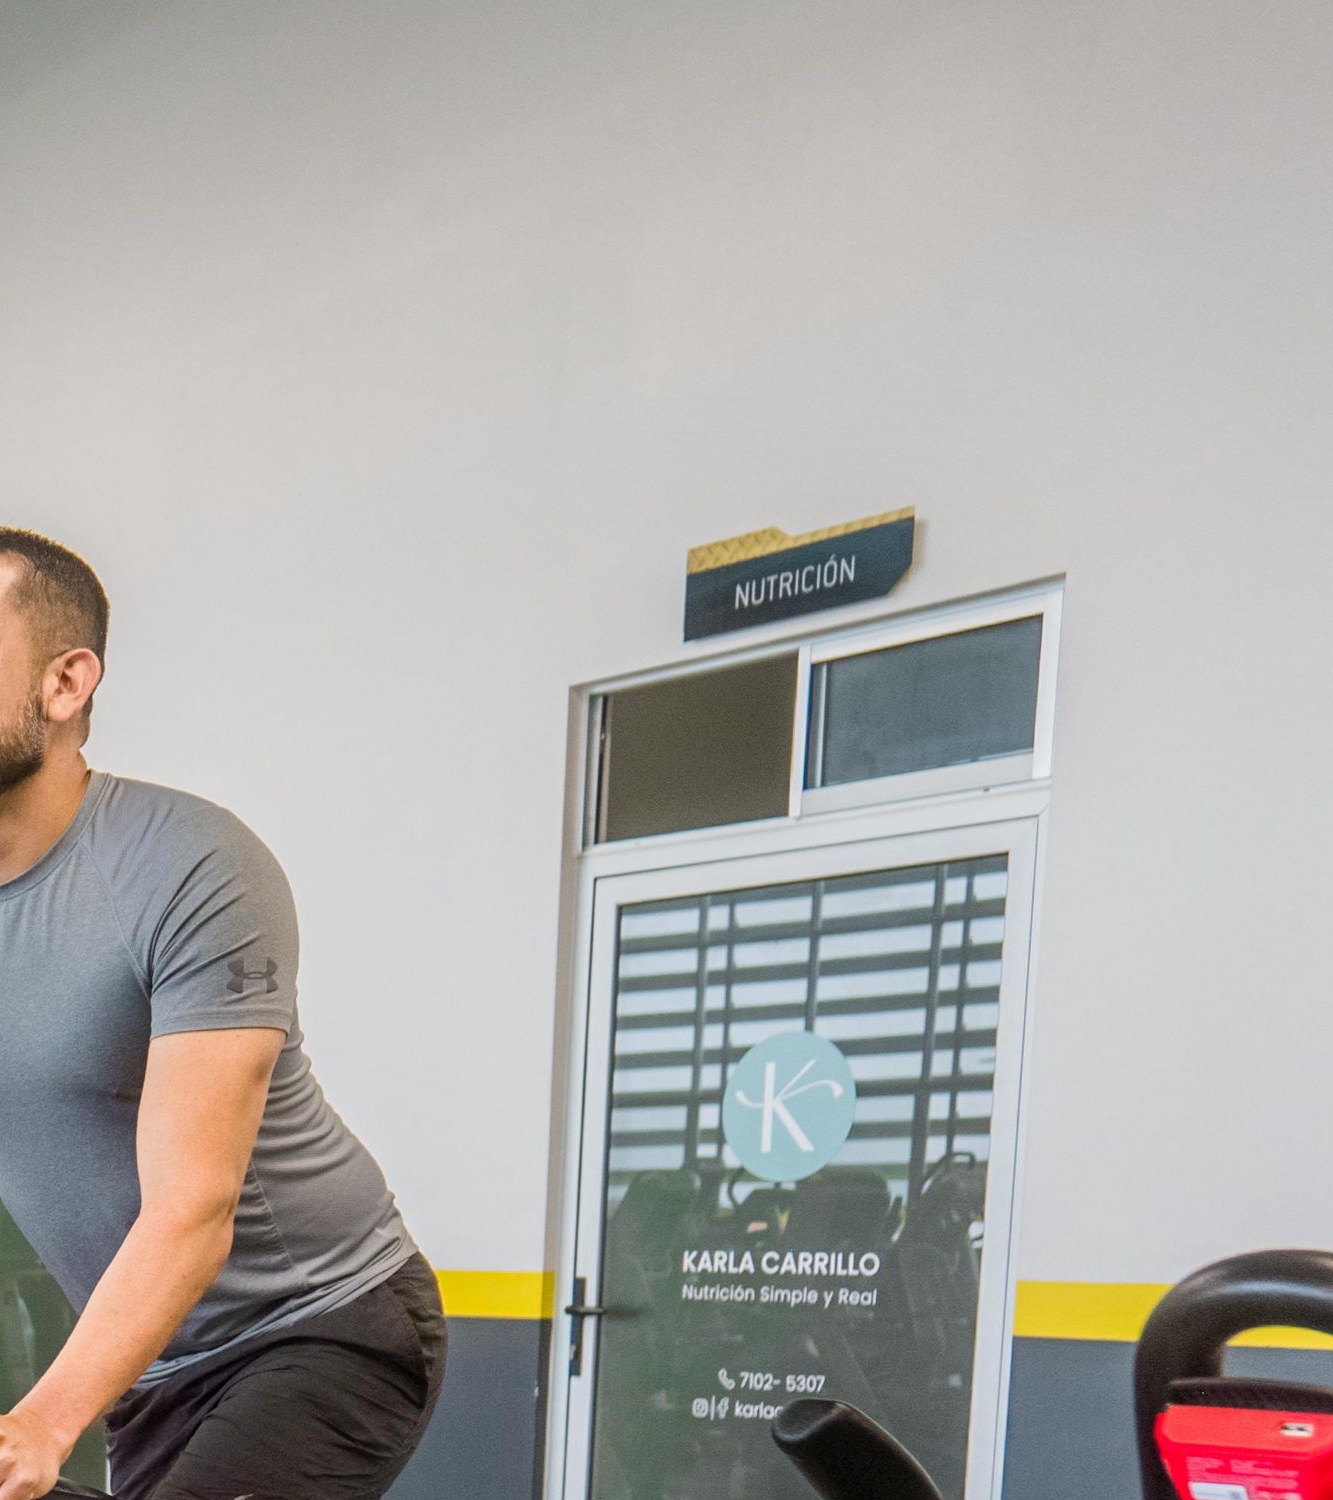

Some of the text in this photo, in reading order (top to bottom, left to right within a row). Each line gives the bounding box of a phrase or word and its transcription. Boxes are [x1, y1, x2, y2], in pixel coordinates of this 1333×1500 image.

[735, 554, 856, 610] NUTRICIÓN
[735, 1058, 844, 1153] K
[683, 1250, 881, 1277] KARLA CARRILLO
[682, 1283, 878, 1309] Nutrición Simple y Real
[786, 1375, 826, 1393] 5307
